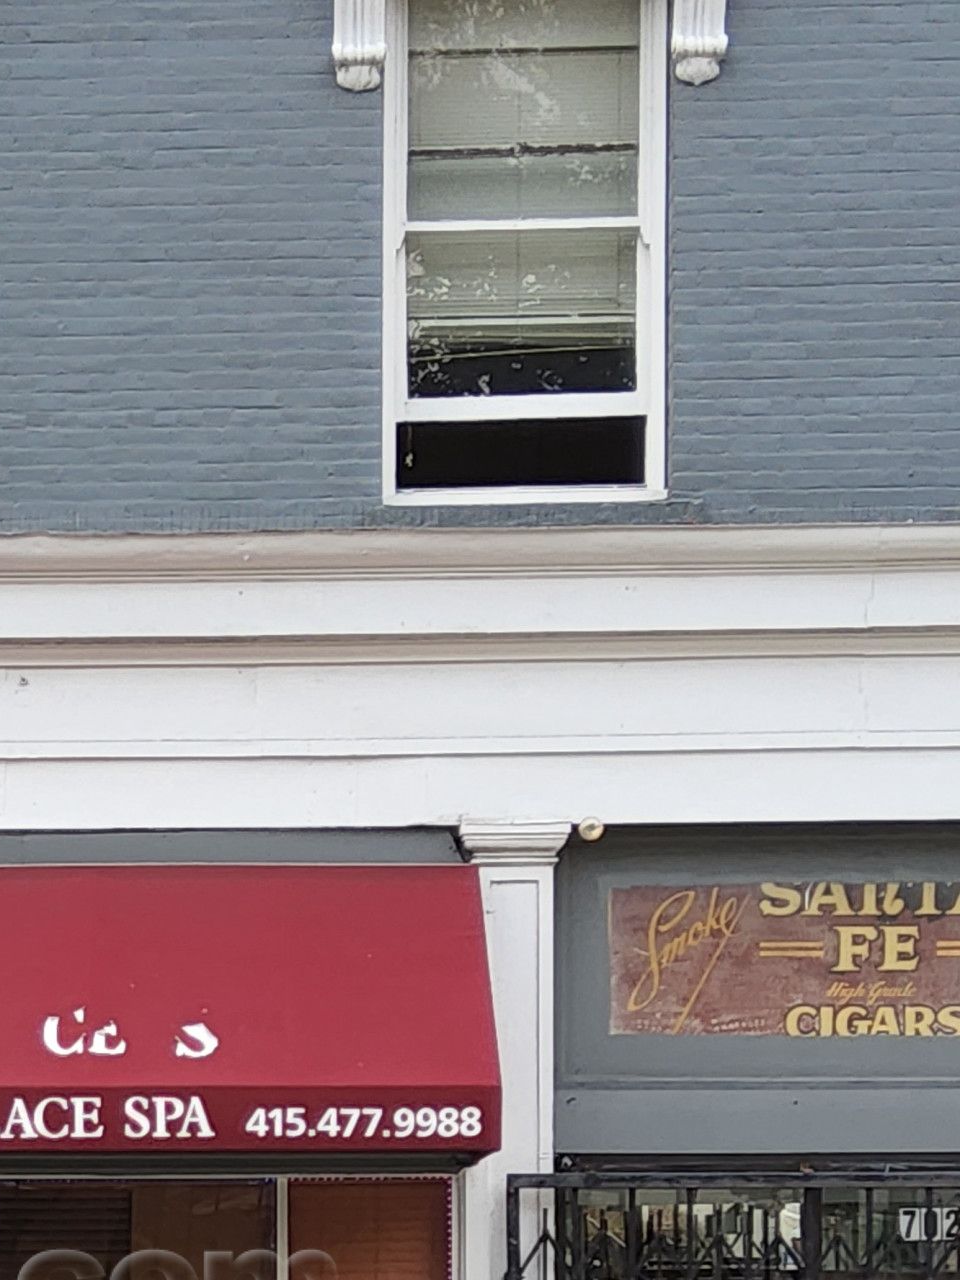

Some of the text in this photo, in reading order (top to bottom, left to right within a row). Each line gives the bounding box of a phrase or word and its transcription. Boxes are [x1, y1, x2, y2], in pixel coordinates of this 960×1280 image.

[627, 887, 751, 1034] Smoke
[830, 925, 920, 972] FE
[785, 1004, 960, 1036] CIGARS
[124, 1096, 216, 1138] SPA
[245, 1106, 482, 1138] 415.477.9988
[902, 1209, 960, 1239] 702
